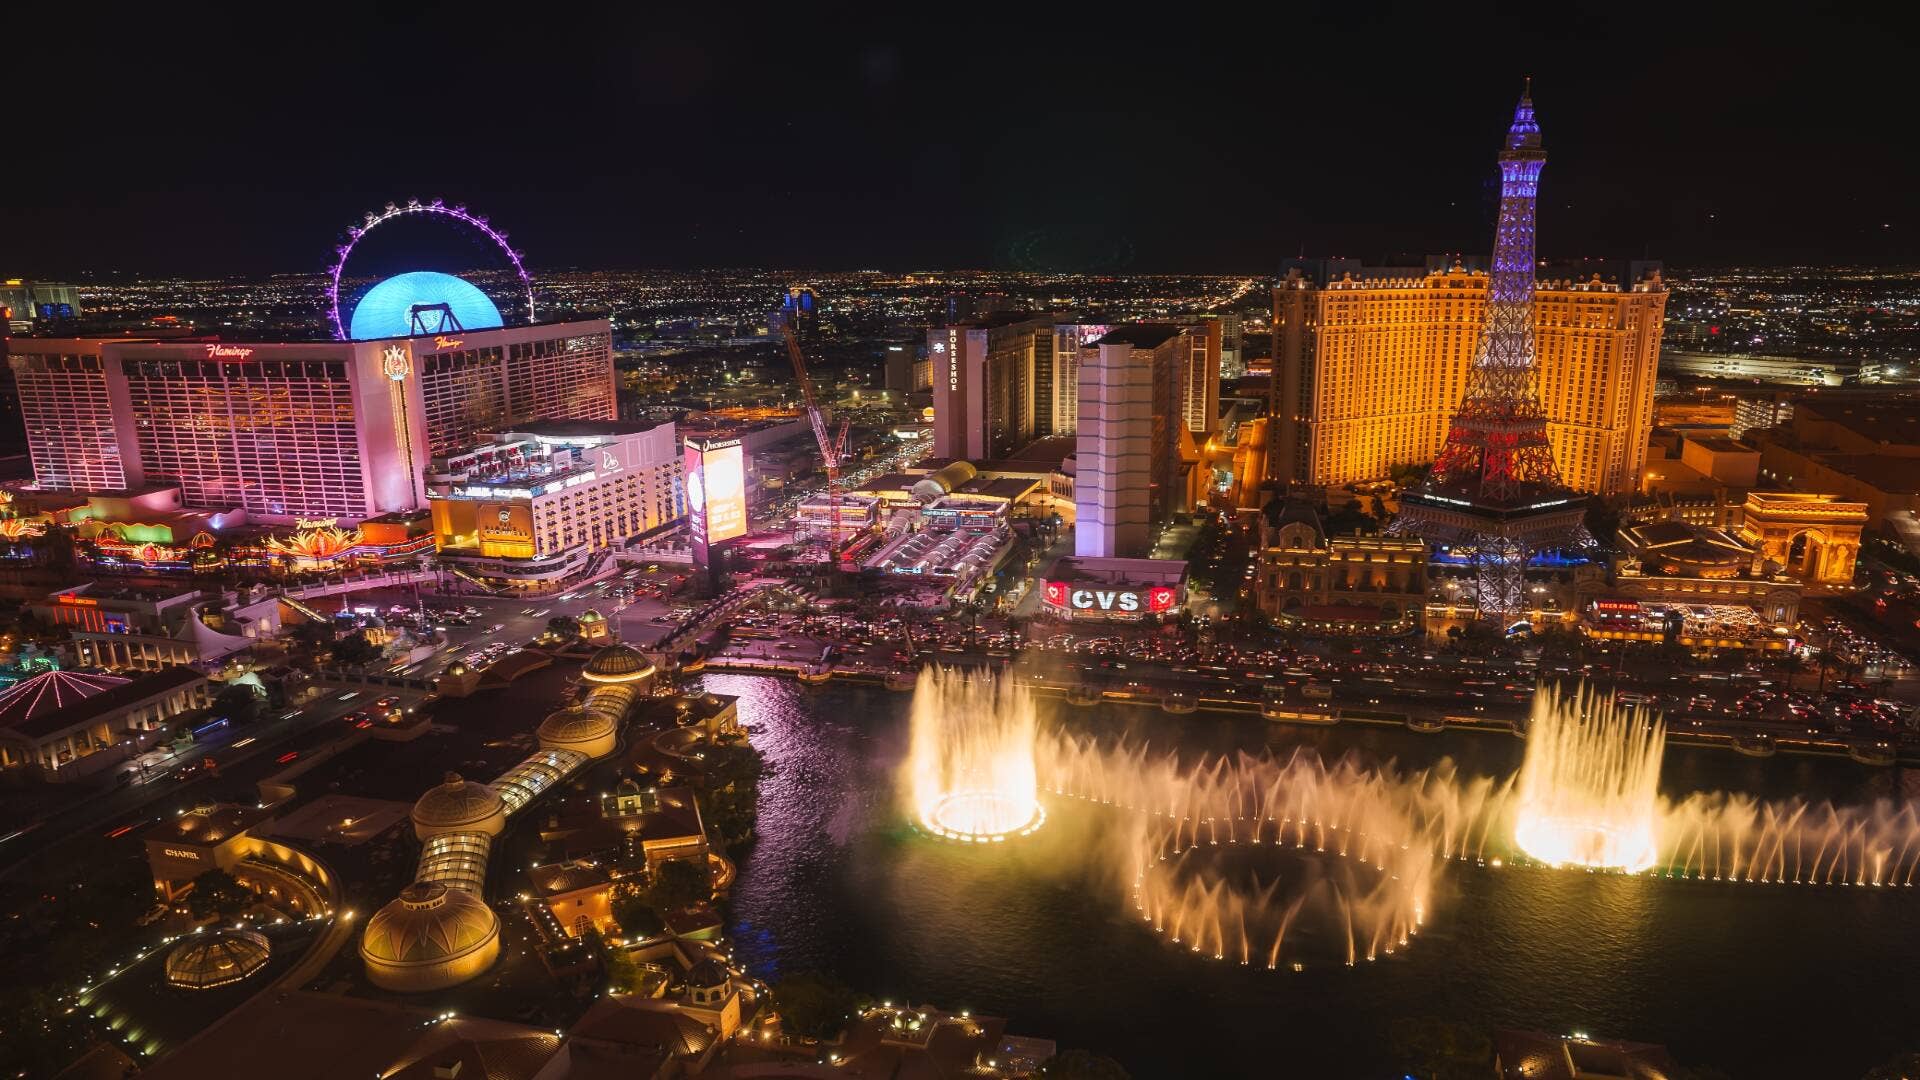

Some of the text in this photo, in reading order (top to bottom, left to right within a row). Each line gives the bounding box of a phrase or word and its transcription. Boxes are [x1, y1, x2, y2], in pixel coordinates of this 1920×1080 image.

[206, 344, 253, 360] Flamingo
[294, 517, 338, 529] Flamingo
[1072, 590, 1138, 611] CVS
[165, 849, 199, 860] CHANEL
